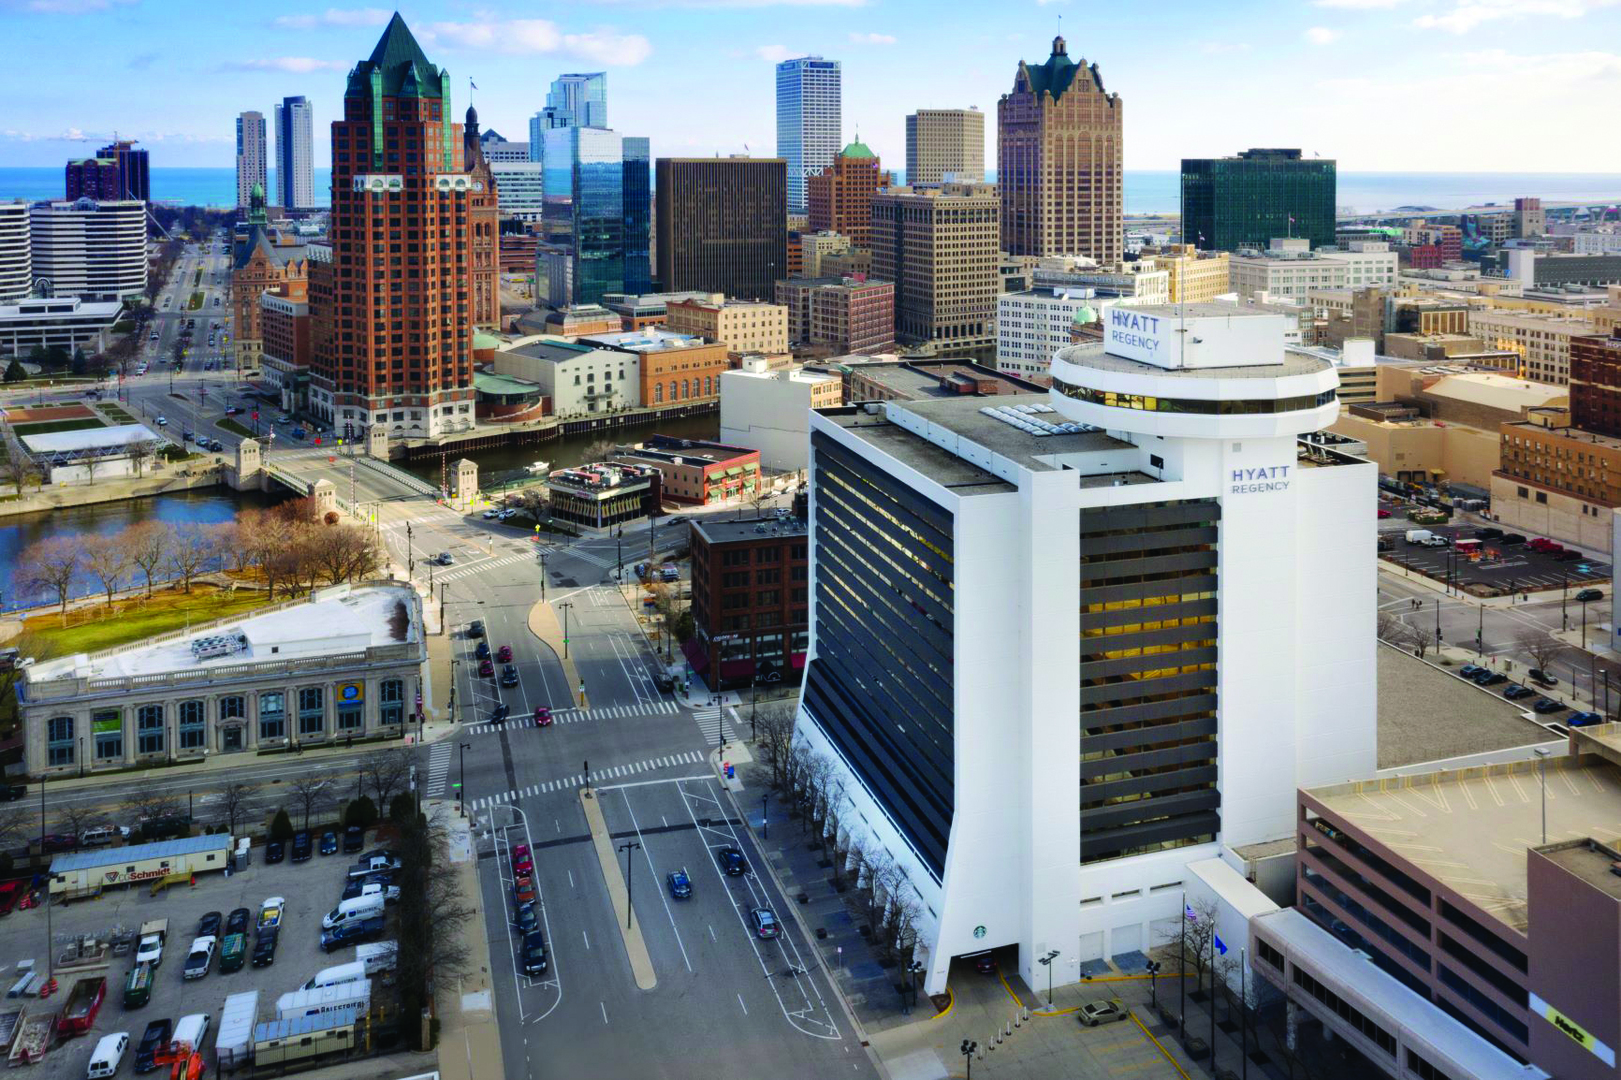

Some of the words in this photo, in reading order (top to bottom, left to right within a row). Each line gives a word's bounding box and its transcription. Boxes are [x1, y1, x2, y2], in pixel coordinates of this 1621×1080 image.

[1112, 309, 1160, 334] HYATT
[1112, 329, 1159, 351] REGENCY
[1232, 465, 1290, 481] HYATT
[1232, 481, 1290, 494] REGENCY
[1554, 1015, 1585, 1043] Hertz
